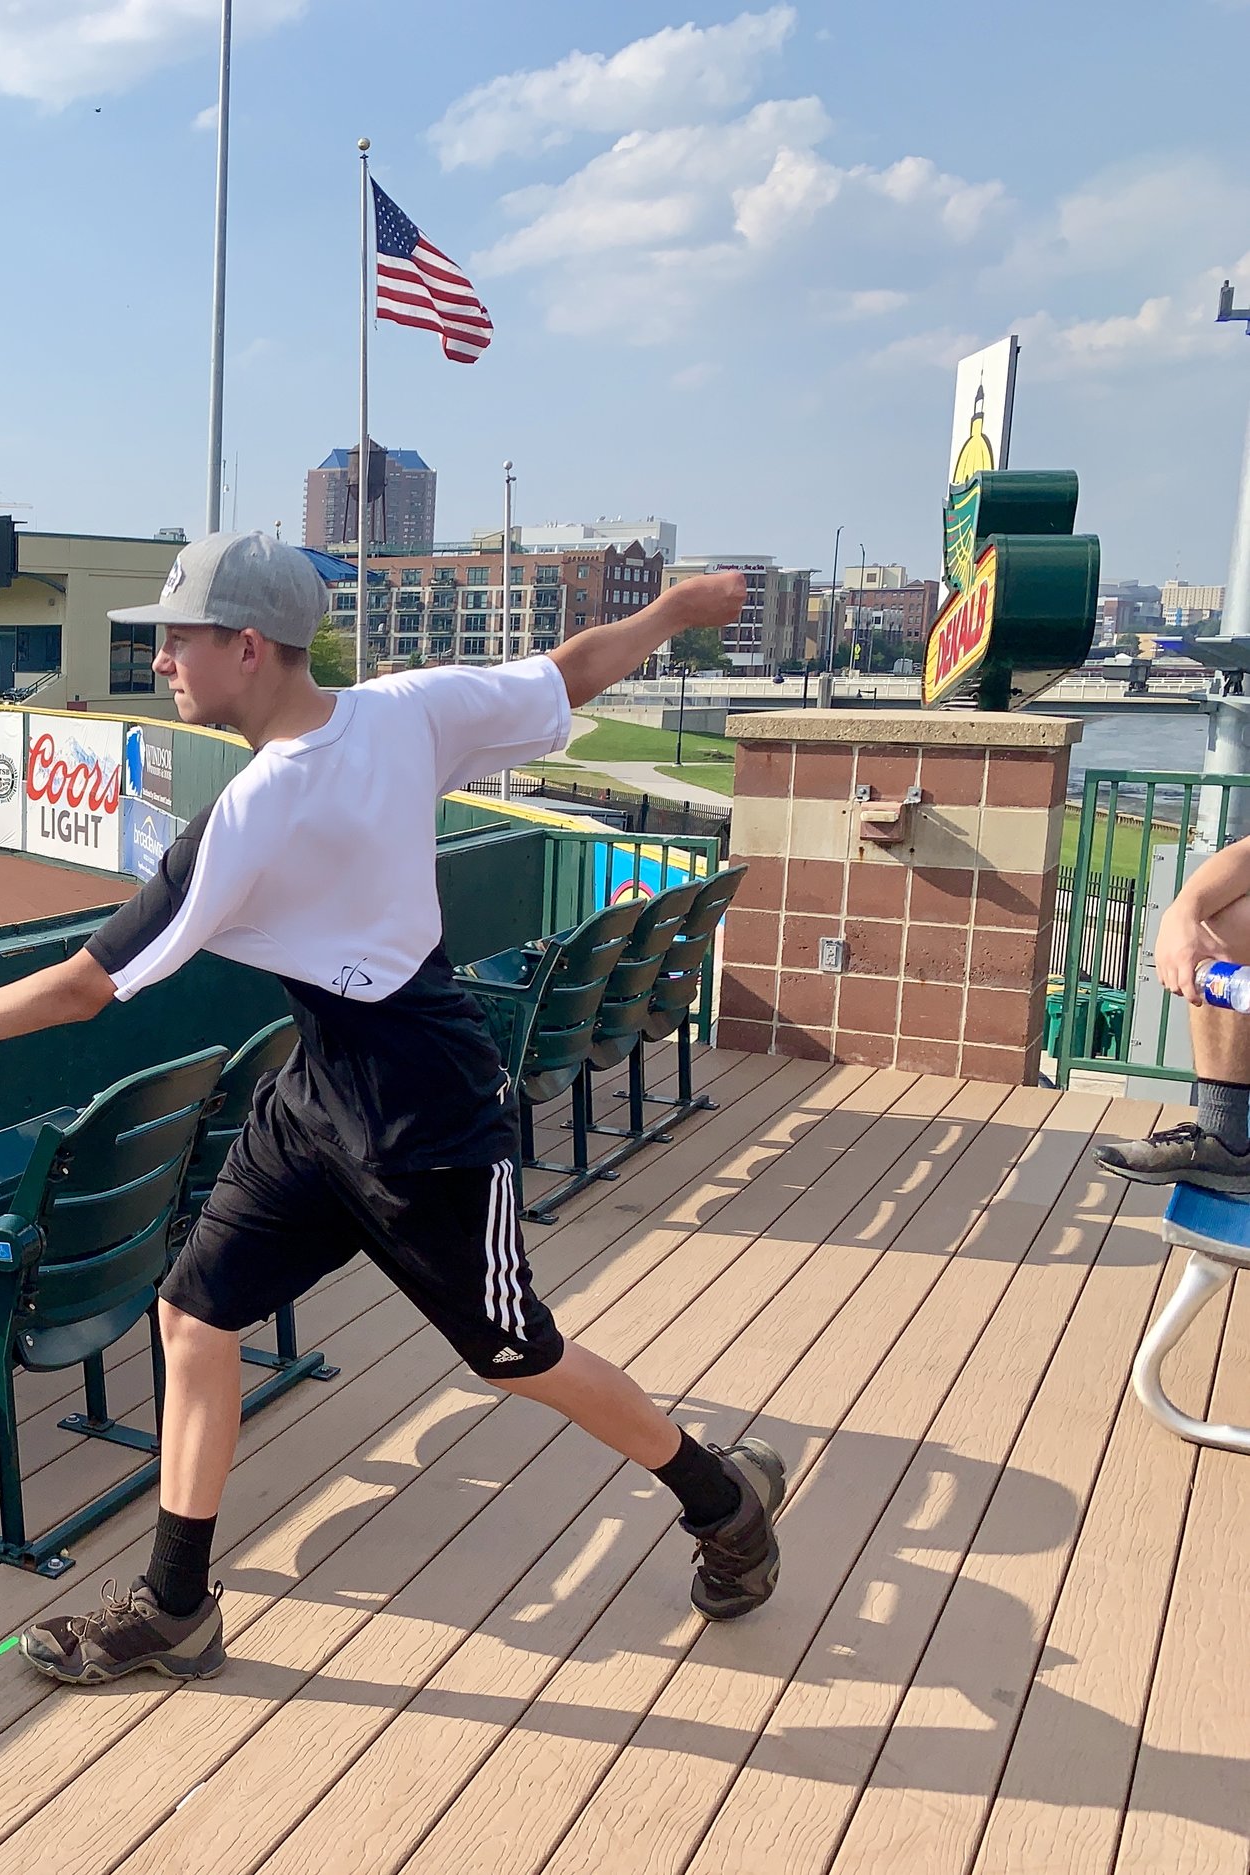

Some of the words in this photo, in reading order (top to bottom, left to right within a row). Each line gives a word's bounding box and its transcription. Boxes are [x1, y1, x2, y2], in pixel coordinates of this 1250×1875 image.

[934, 580, 988, 688] DEKALB
[26, 733, 123, 815] Coors
[146, 743, 172, 773] WINDSOR
[41, 805, 102, 849] LIGHT
[492, 1353, 524, 1363] adidas
